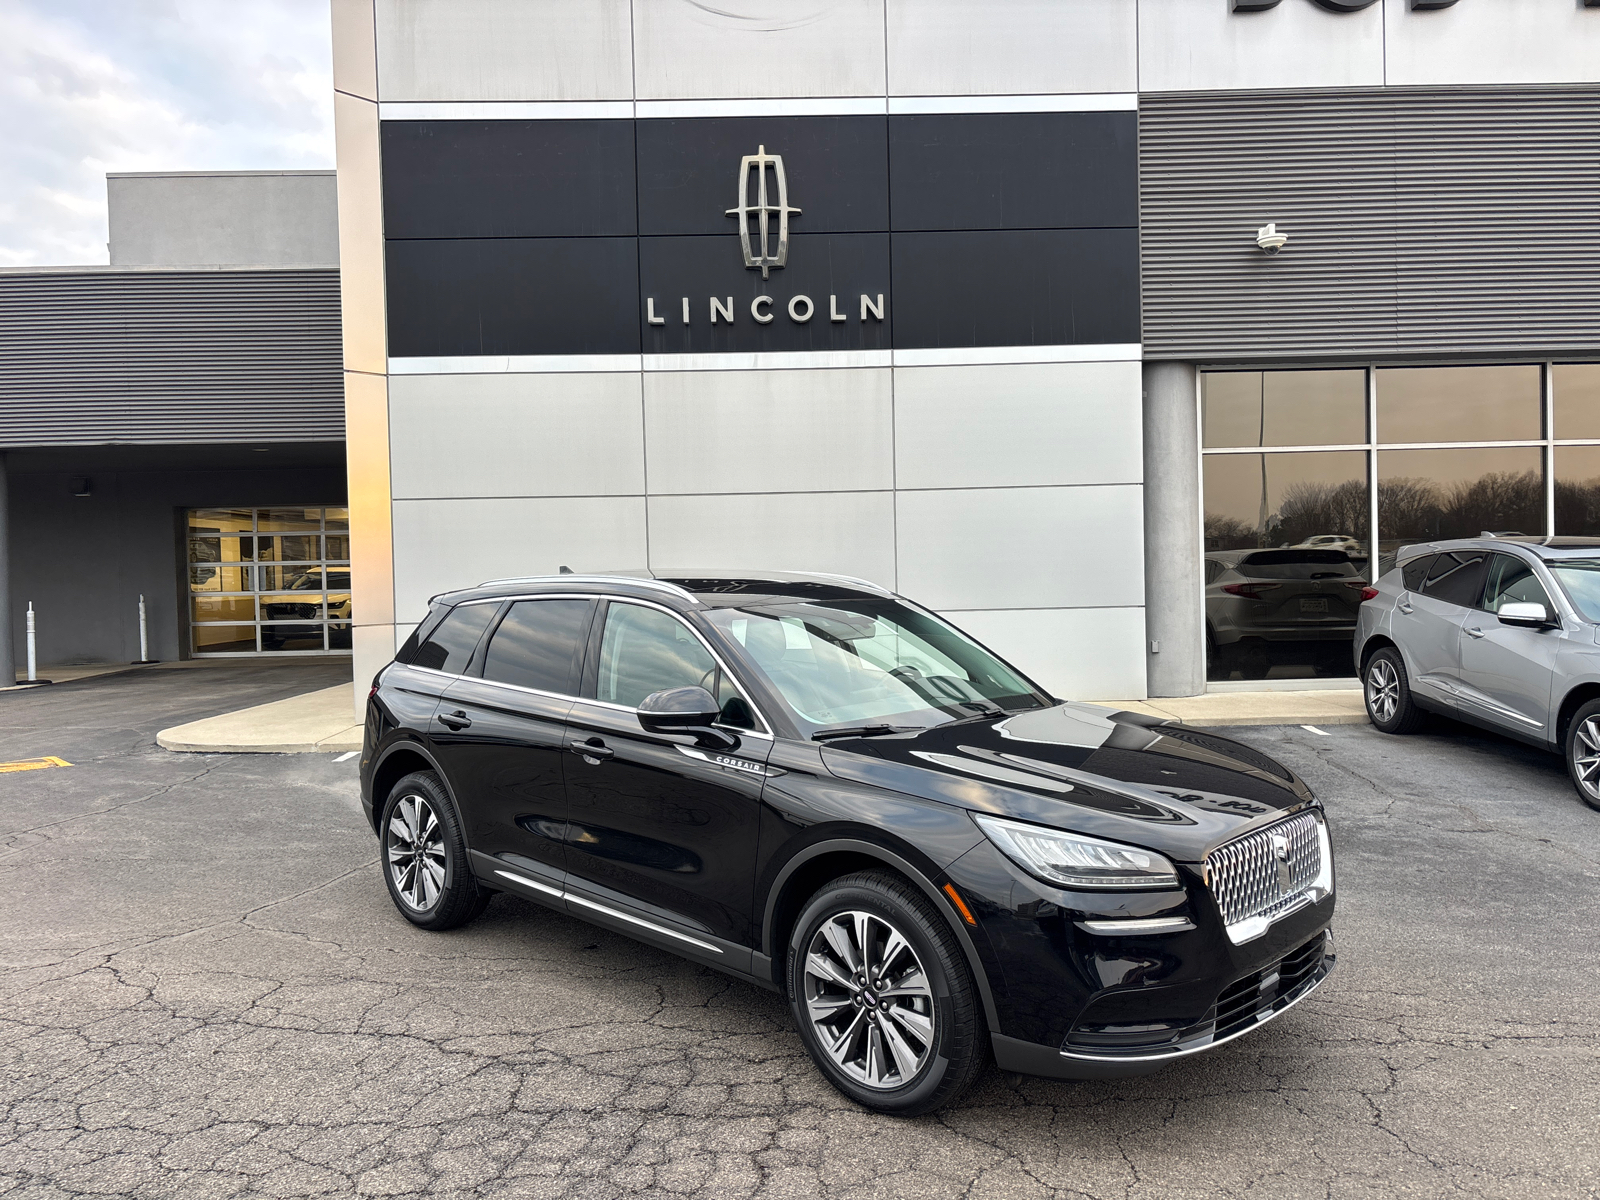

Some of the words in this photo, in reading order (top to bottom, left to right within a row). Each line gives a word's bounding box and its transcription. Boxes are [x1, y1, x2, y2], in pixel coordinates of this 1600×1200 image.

[647, 294, 884, 325] LINCOLN
[716, 756, 760, 771] CORSAIR
[835, 893, 896, 916] CONTINENTAL
